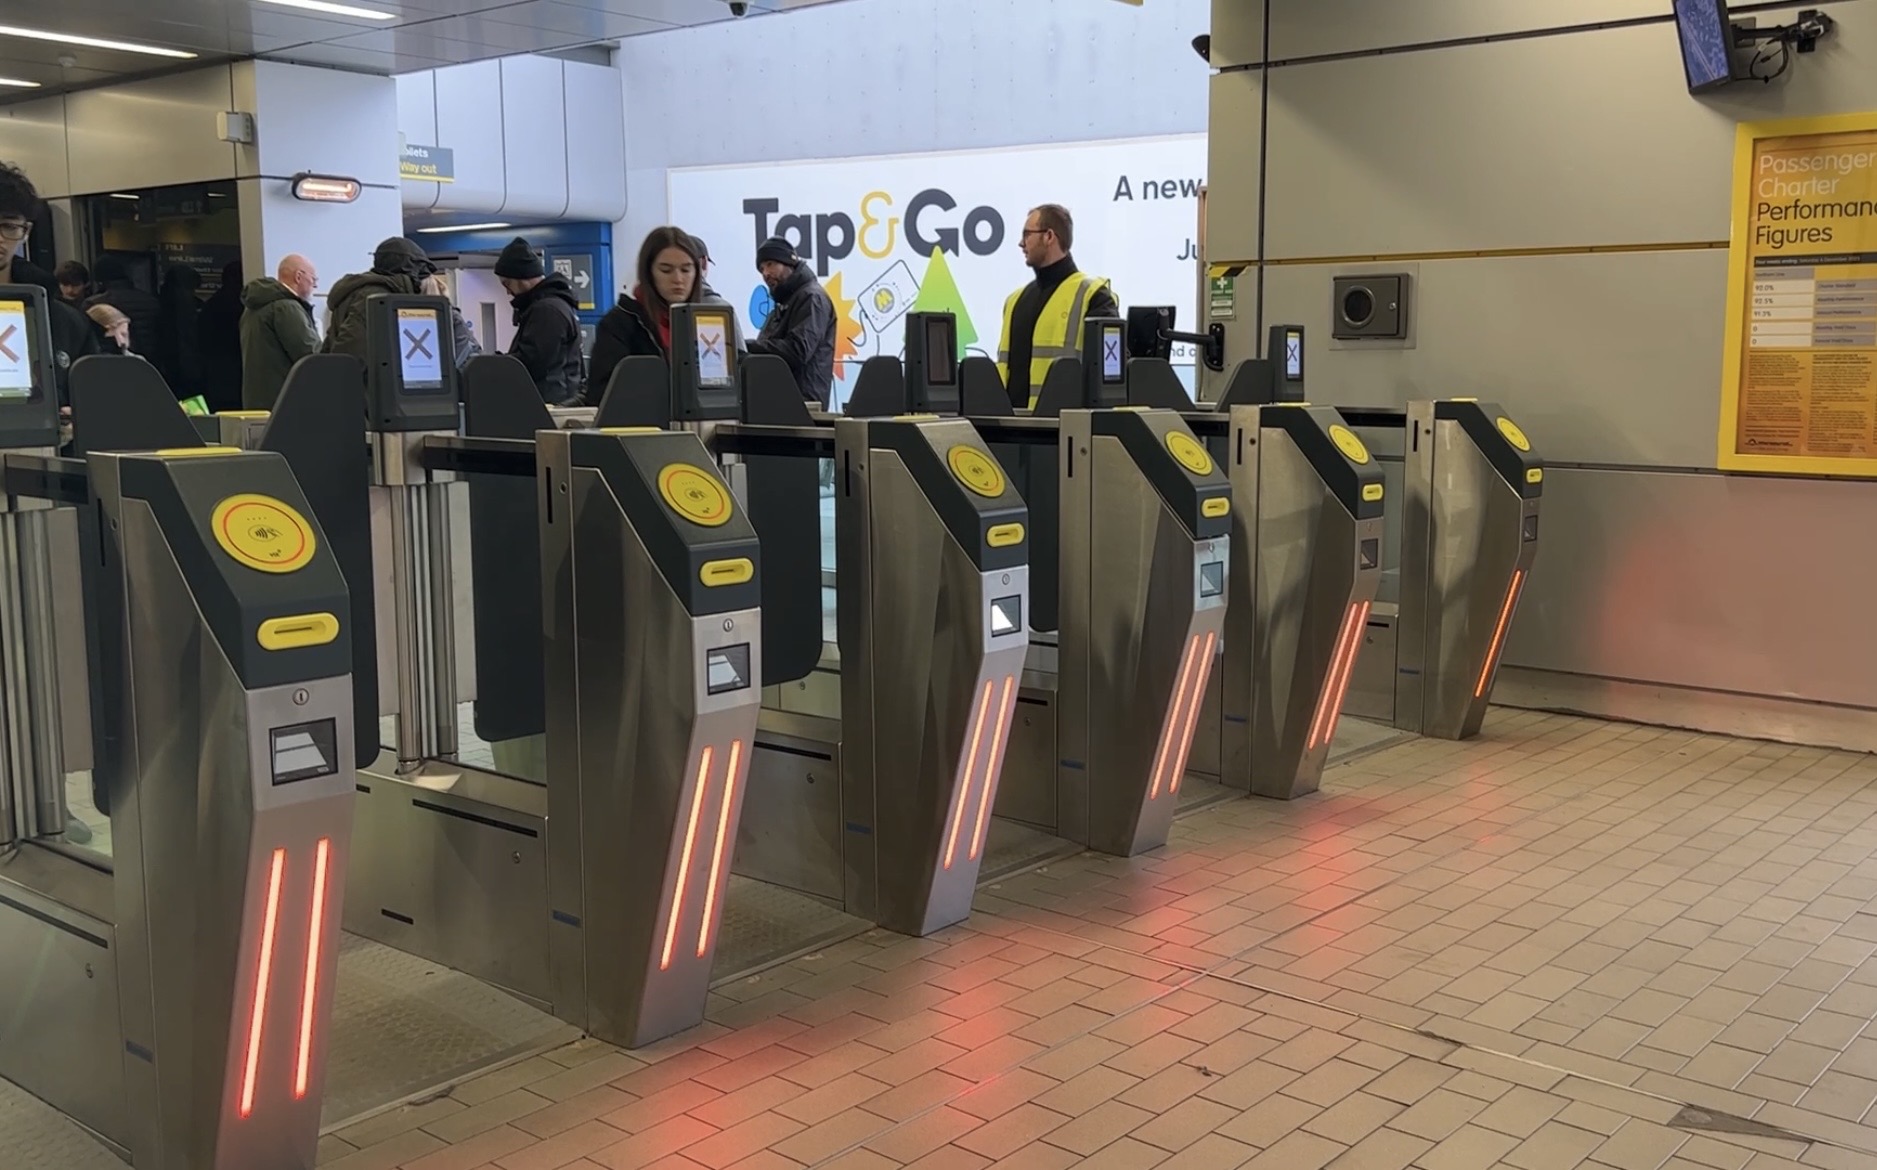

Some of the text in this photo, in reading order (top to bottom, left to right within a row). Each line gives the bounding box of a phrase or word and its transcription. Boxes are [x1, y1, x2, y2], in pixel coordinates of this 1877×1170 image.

[421, 164, 437, 175] out
[1759, 151, 1877, 175] Passenger
[1113, 175, 1202, 202] A new
[1758, 176, 1840, 198] Charter
[1755, 225, 1833, 250] Figures
